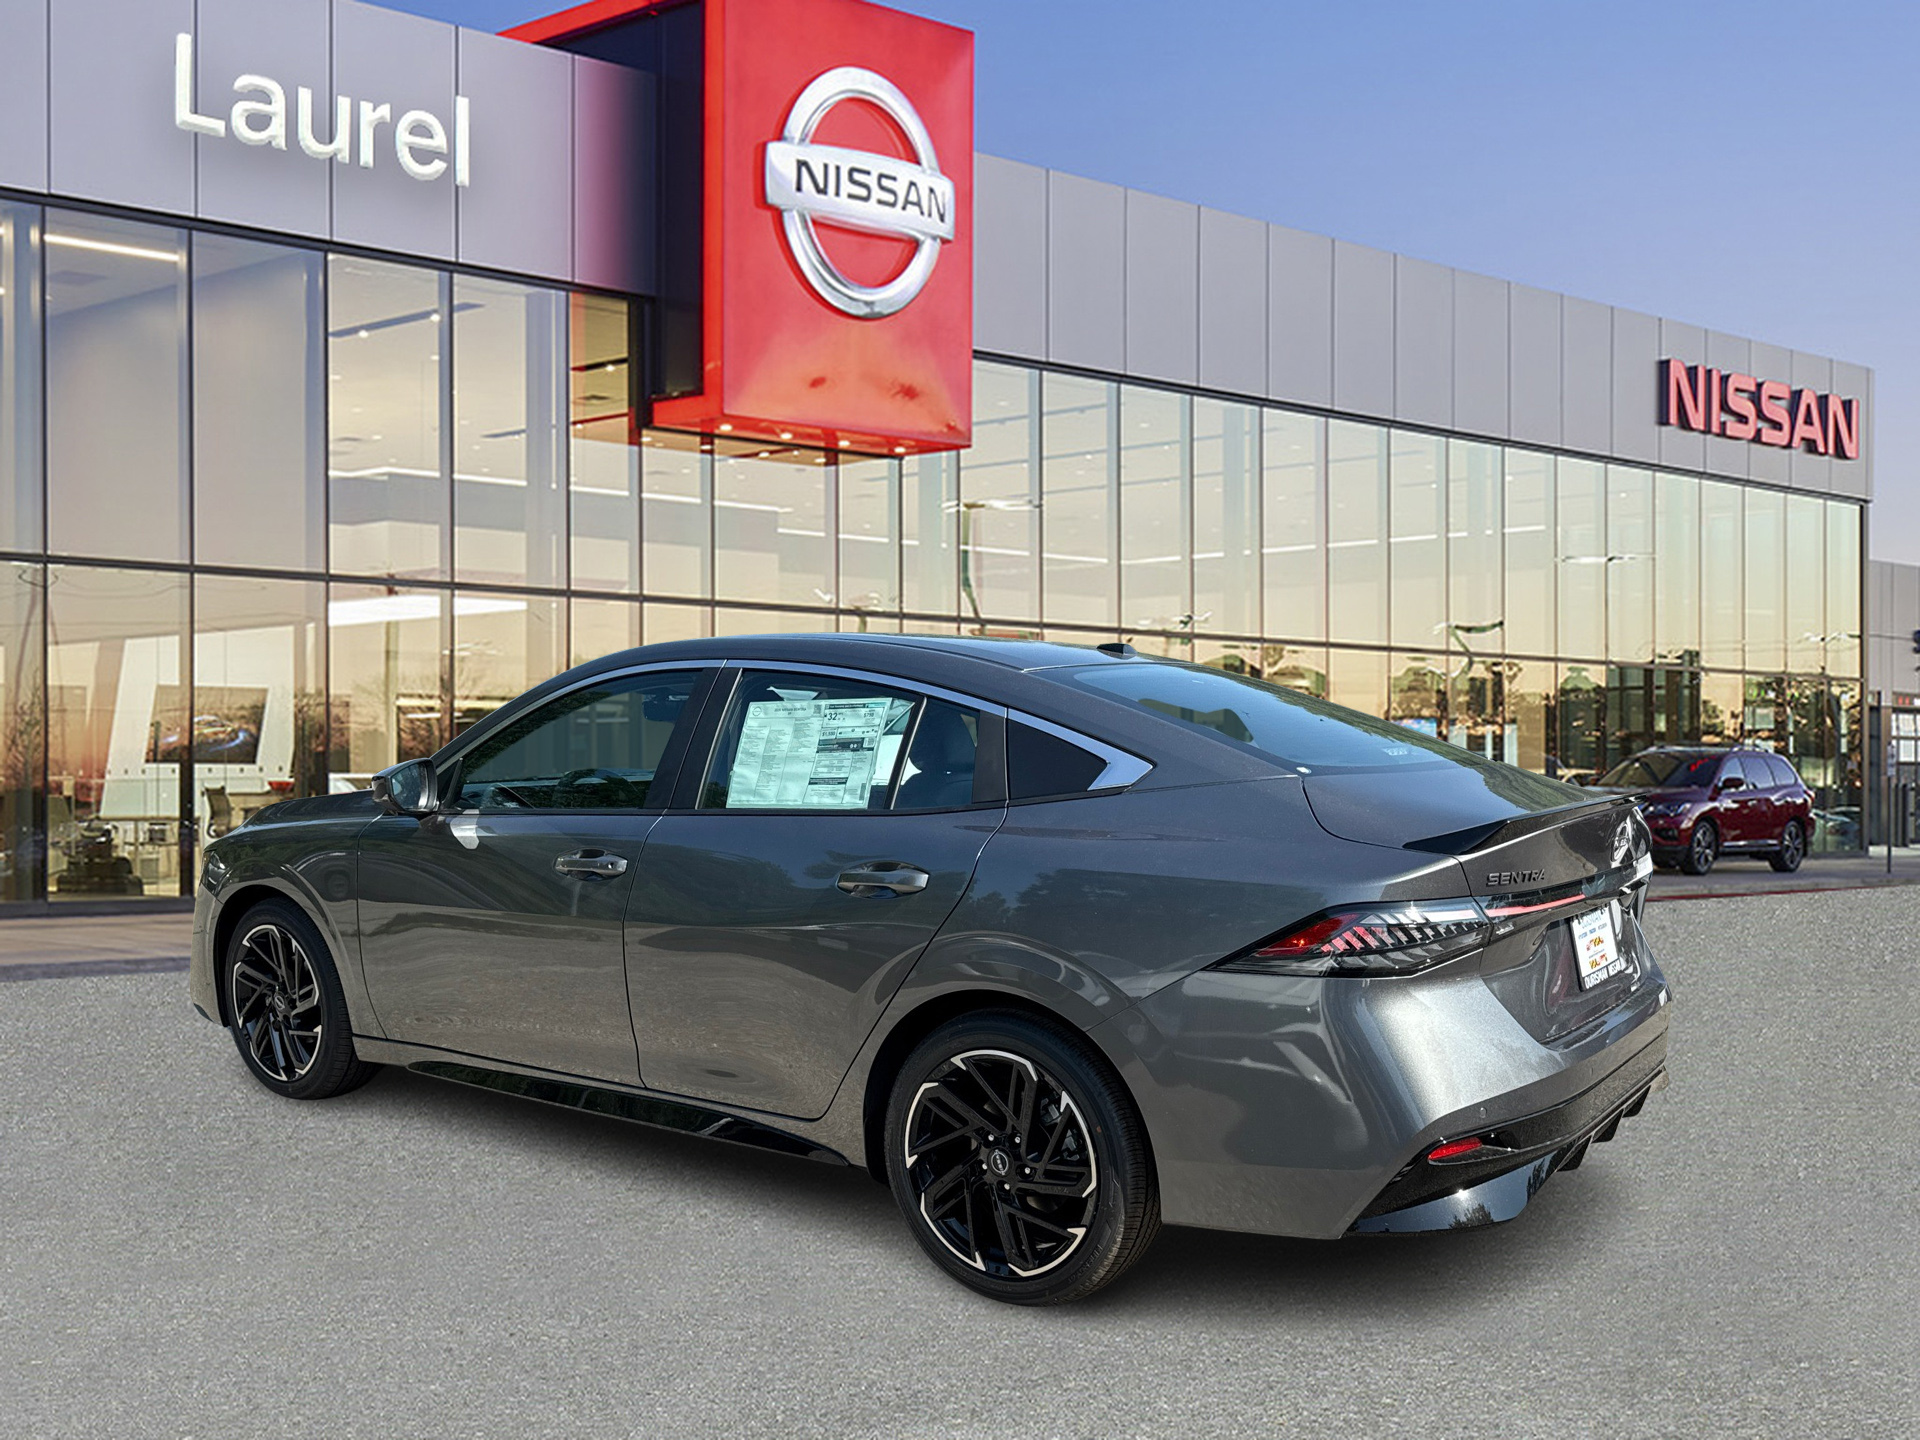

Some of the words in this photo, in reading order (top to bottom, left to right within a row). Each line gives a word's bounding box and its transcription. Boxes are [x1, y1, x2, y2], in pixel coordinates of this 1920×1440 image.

[175, 33, 470, 187] Laurel
[796, 159, 946, 224] NISSAN
[1659, 358, 1860, 459] NISSAN
[1487, 869, 1545, 887] SENTRA
